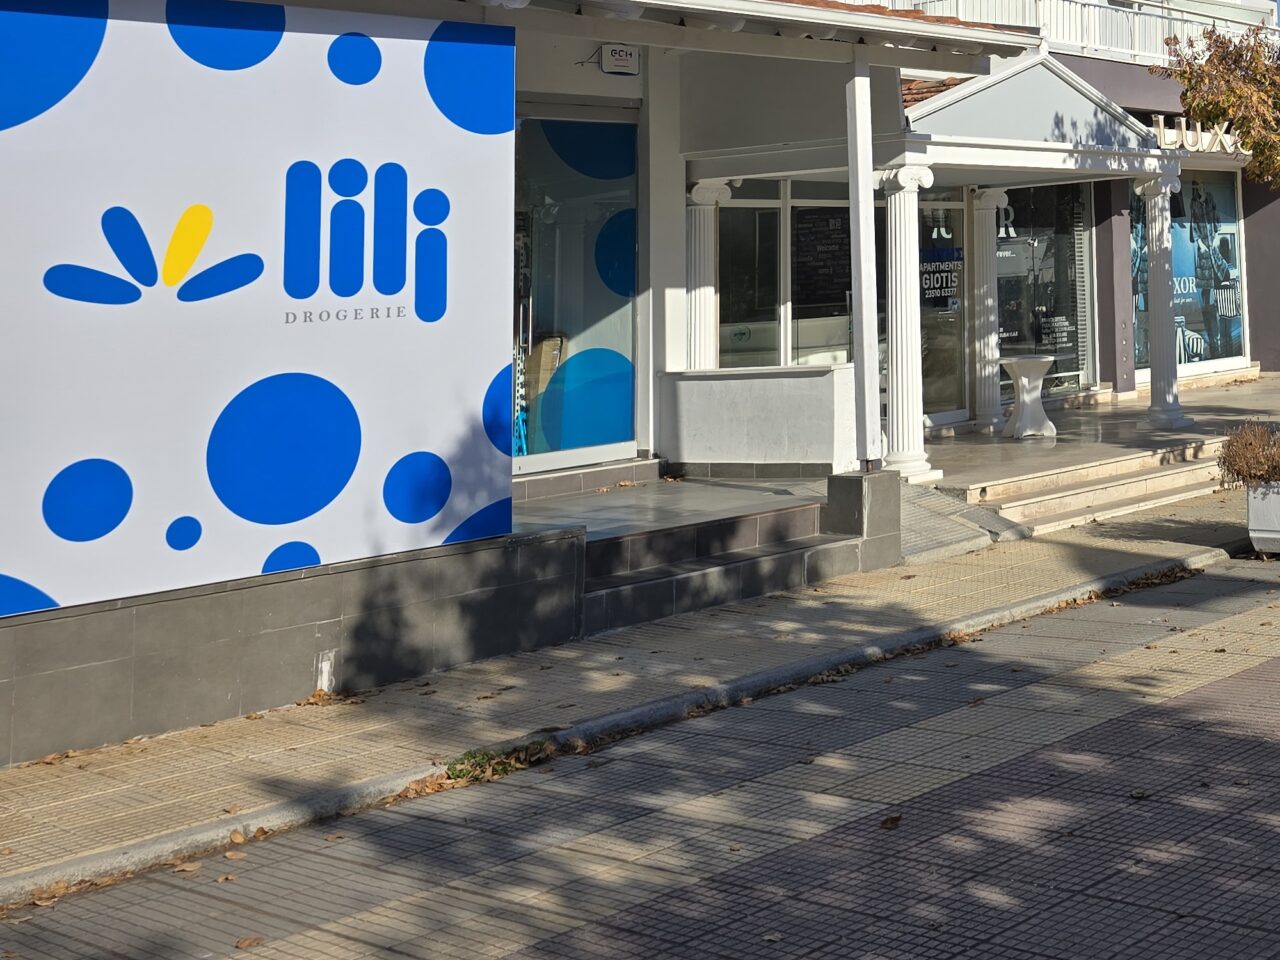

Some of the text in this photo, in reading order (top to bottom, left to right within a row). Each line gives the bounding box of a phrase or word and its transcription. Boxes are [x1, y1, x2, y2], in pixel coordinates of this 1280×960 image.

[283, 158, 450, 322] lili
[919, 261, 962, 271] APARTMENTS
[922, 272, 958, 288] GIOTIS
[1173, 276, 1198, 295] XOR
[925, 289, 940, 298] 23510
[284, 306, 407, 324] DROGERIE
